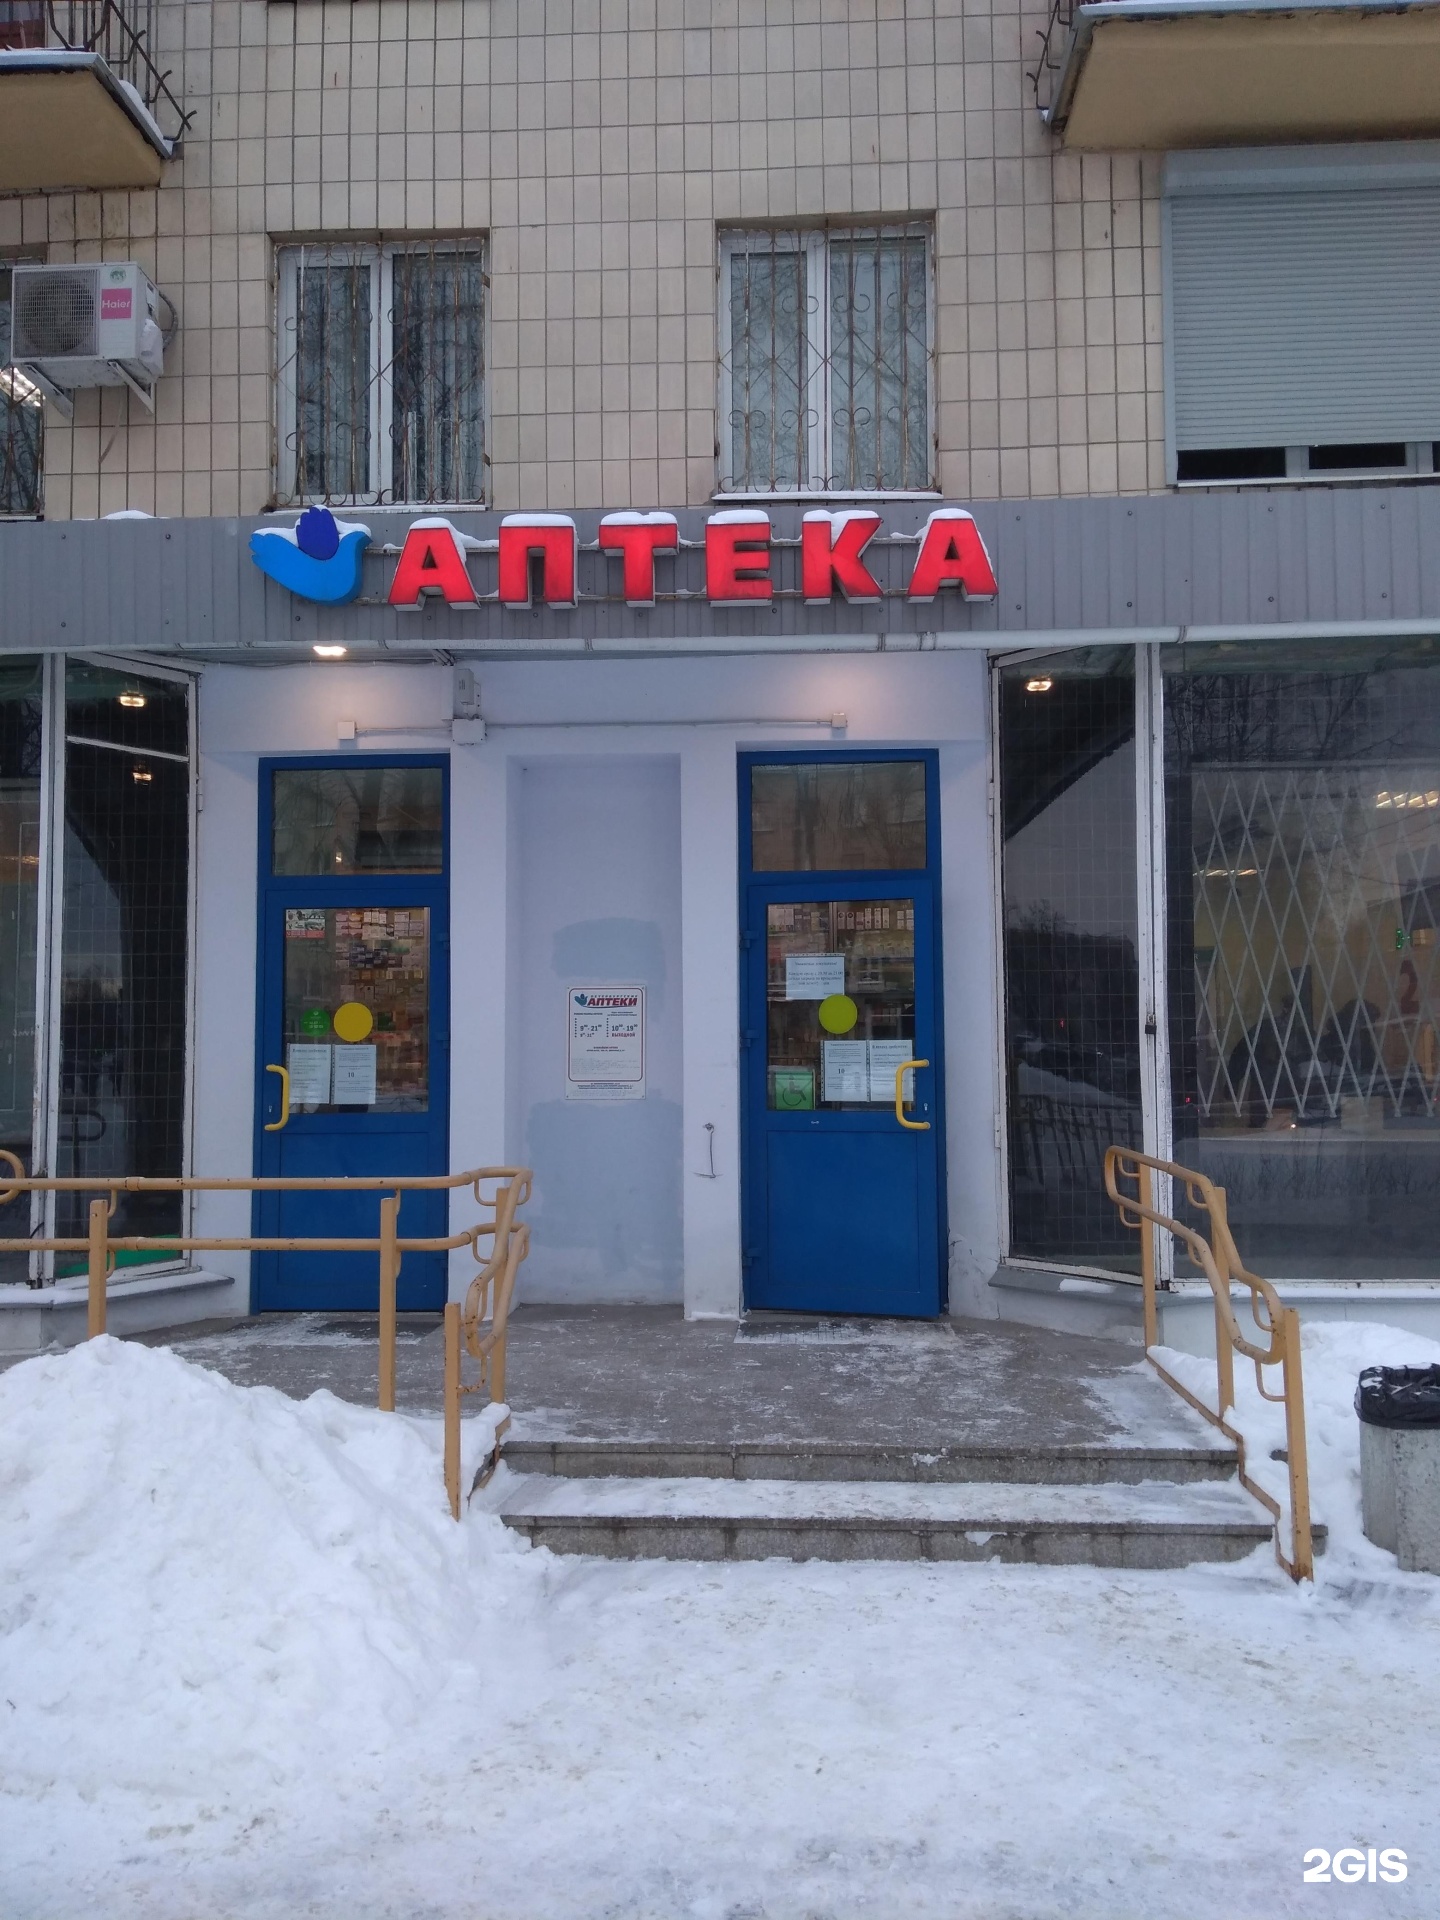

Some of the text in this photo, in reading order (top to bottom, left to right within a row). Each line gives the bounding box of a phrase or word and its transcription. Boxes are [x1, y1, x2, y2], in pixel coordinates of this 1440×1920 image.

[102, 299, 131, 309] Haier
[388, 515, 999, 611] АПТЕКА
[587, 997, 638, 1006] АПТЕКИ
